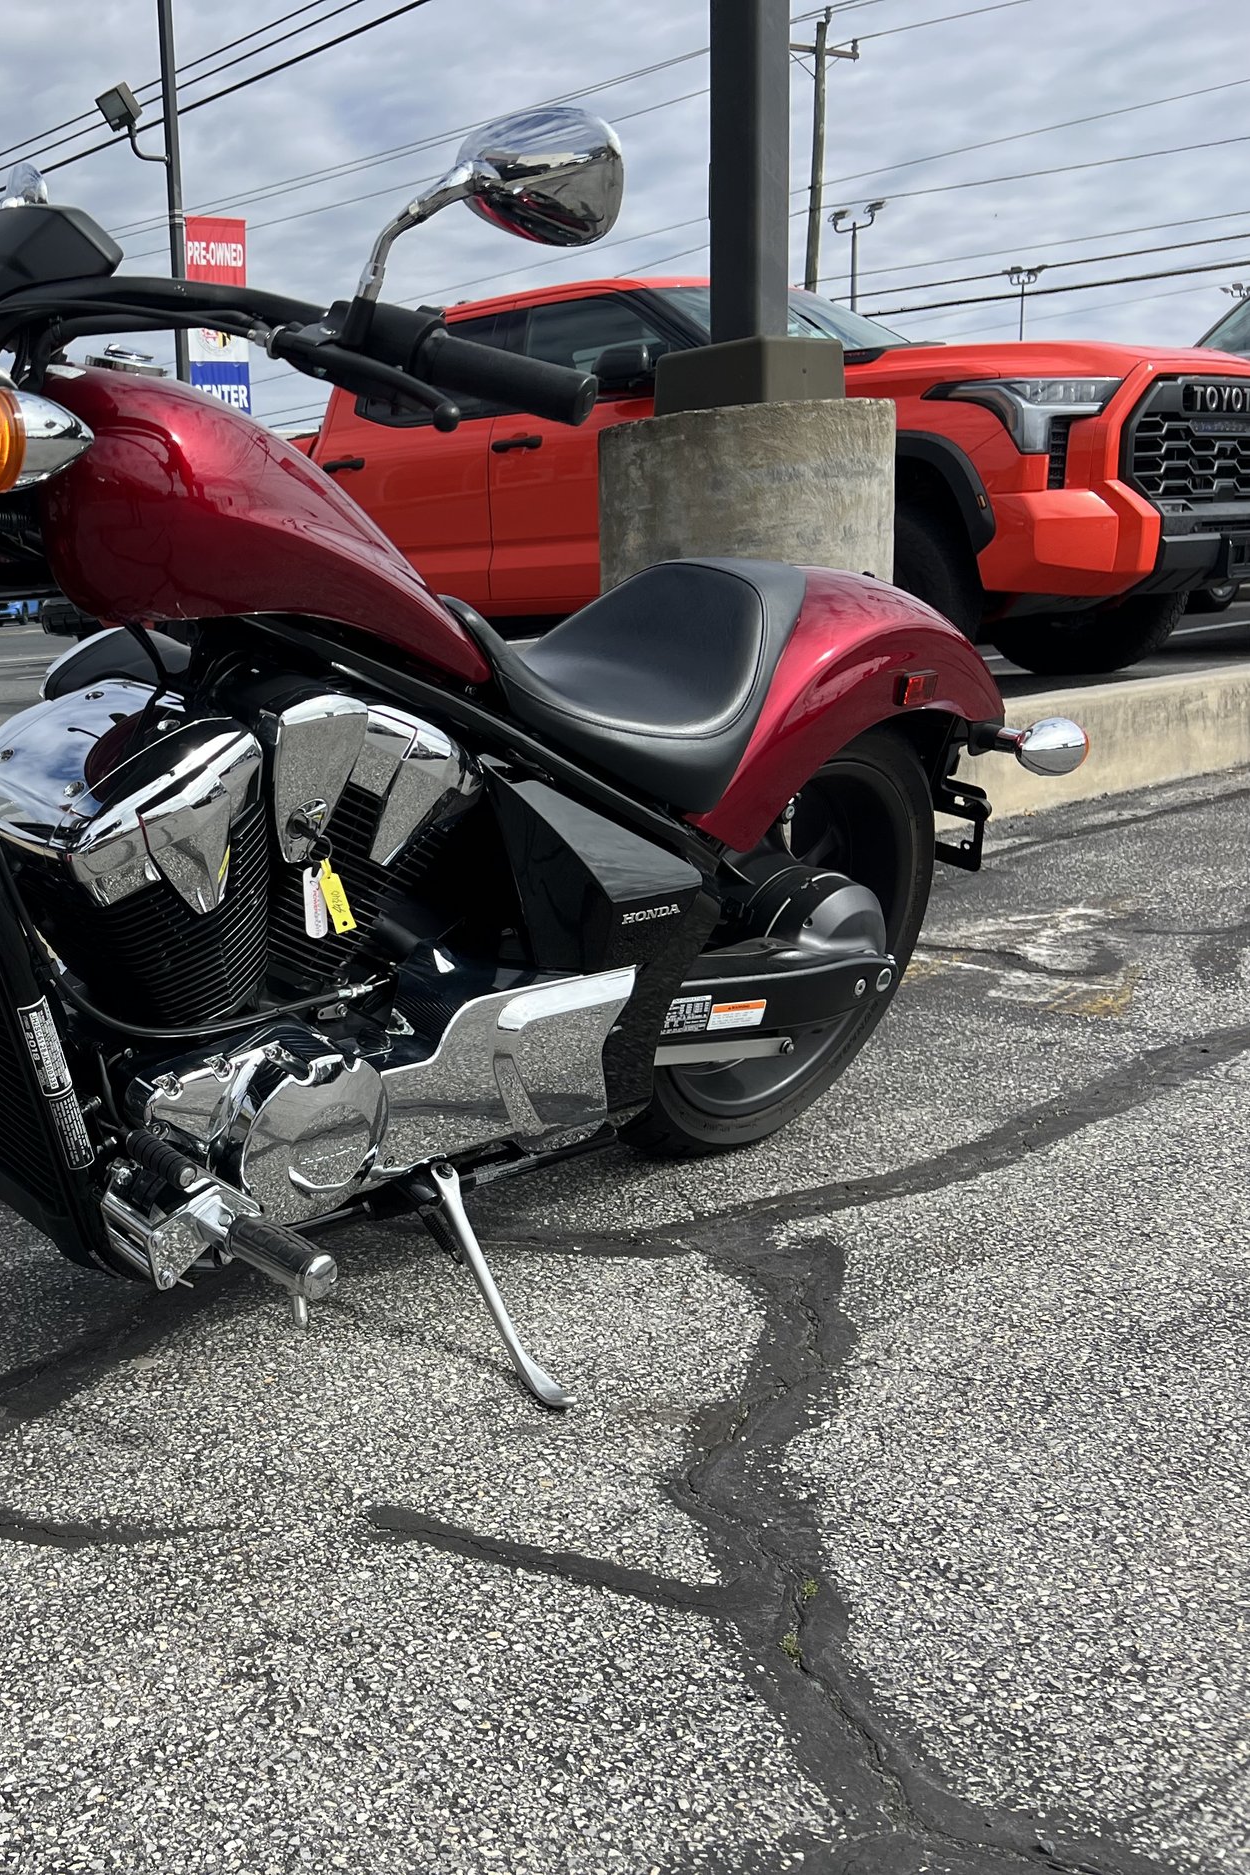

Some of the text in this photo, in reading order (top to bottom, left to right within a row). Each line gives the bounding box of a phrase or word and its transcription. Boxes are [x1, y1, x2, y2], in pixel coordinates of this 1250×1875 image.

[187, 241, 244, 267] PRE-OWNED
[195, 384, 249, 408] NTER
[621, 903, 681, 925] HONDA
[24, 1031, 41, 1062] 2018
